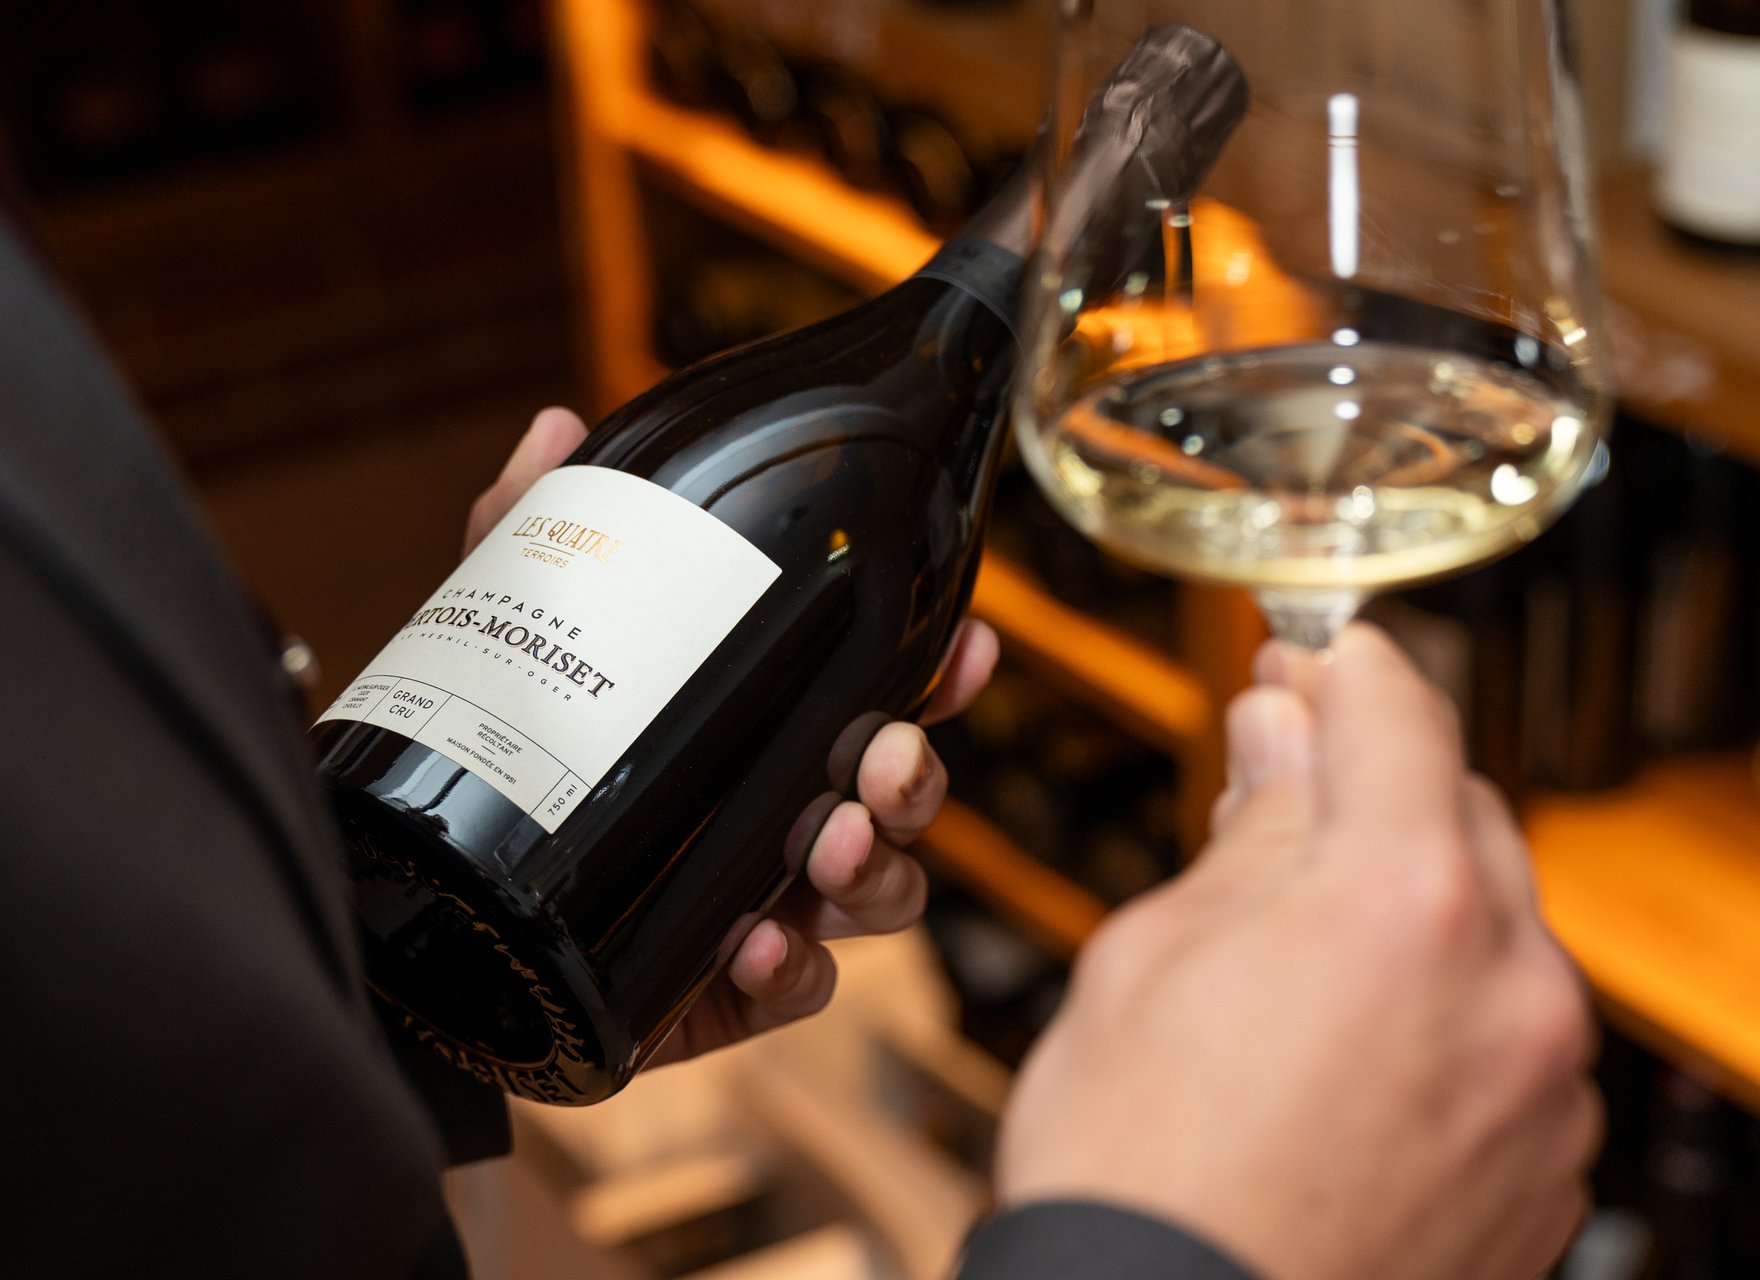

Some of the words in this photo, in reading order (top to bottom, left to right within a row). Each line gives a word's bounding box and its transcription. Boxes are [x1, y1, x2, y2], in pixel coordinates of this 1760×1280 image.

[512, 516, 552, 538] LES
[547, 520, 624, 564] QUATRE
[520, 548, 570, 568] TERROIRS
[442, 587, 582, 640] CHAMPAGNE
[404, 606, 615, 698] ERTOIS-MORISET
[389, 704, 415, 719] CRU
[393, 690, 434, 709] GRAND
[477, 731, 514, 757] RÉCOLTANT
[478, 722, 523, 754] PROPRIÉTAIRE
[446, 736, 471, 754] MAISON
[470, 750, 495, 769] FONDÉE
[493, 766, 504, 776] EN
[502, 773, 517, 785] 1951
[547, 797, 566, 816] 750
[566, 783, 578, 797] ml
